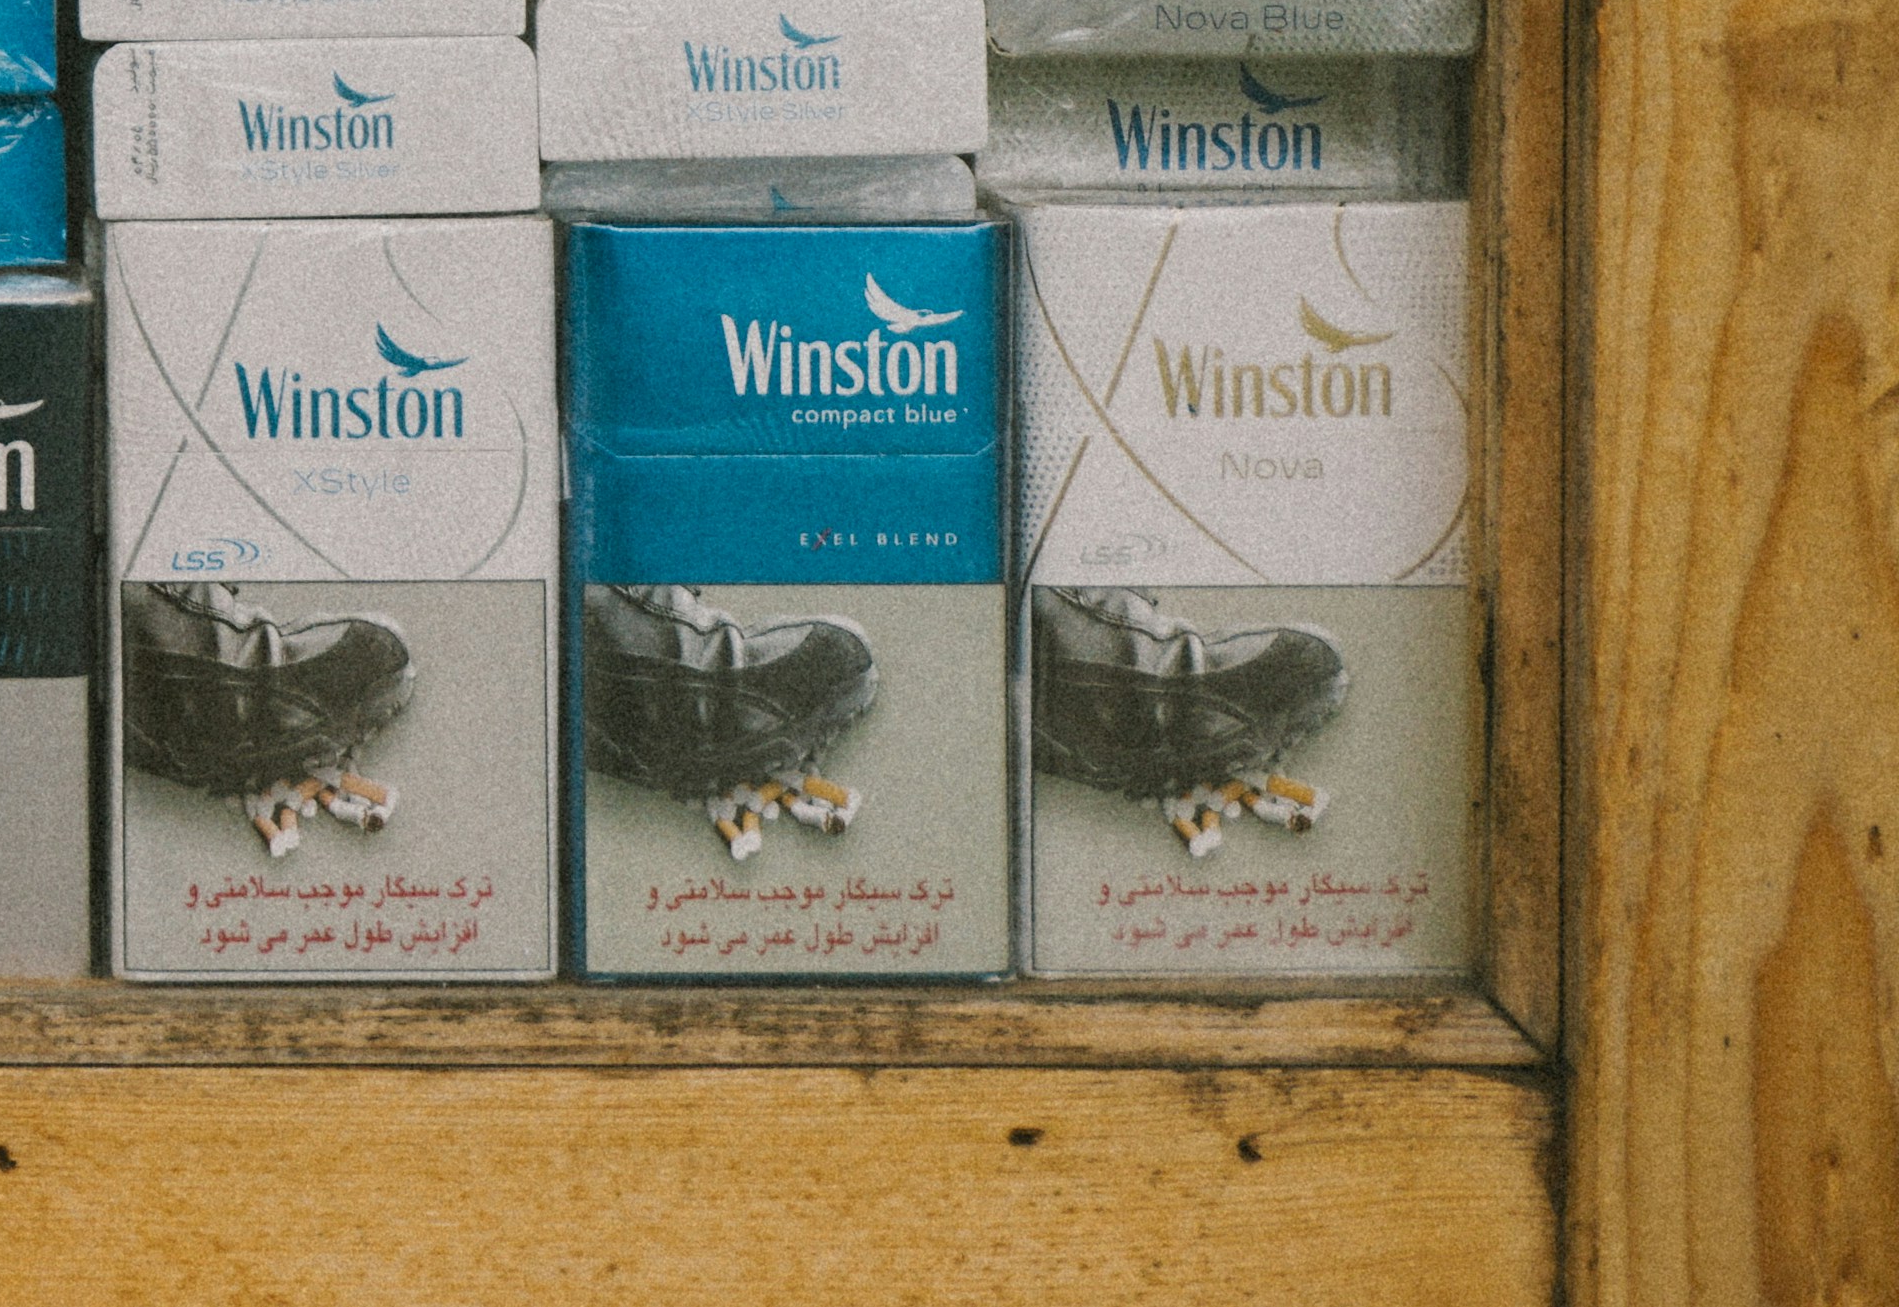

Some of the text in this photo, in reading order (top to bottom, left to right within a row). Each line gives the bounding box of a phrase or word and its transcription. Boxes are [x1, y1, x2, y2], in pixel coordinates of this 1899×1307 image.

[1155, 3, 1344, 30] Nova Blue
[685, 41, 840, 94] Winston
[239, 98, 393, 152] Winston
[1107, 100, 1321, 171] Winston
[722, 314, 958, 396] Winston
[236, 361, 463, 439] Winston
[1154, 339, 1392, 419] Winston
[792, 403, 958, 426] compact blue
[292, 467, 410, 499] XStyle
[1220, 452, 1325, 481] Nova
[171, 550, 224, 571] LSS
[800, 533, 958, 547] EXEL BLEND
